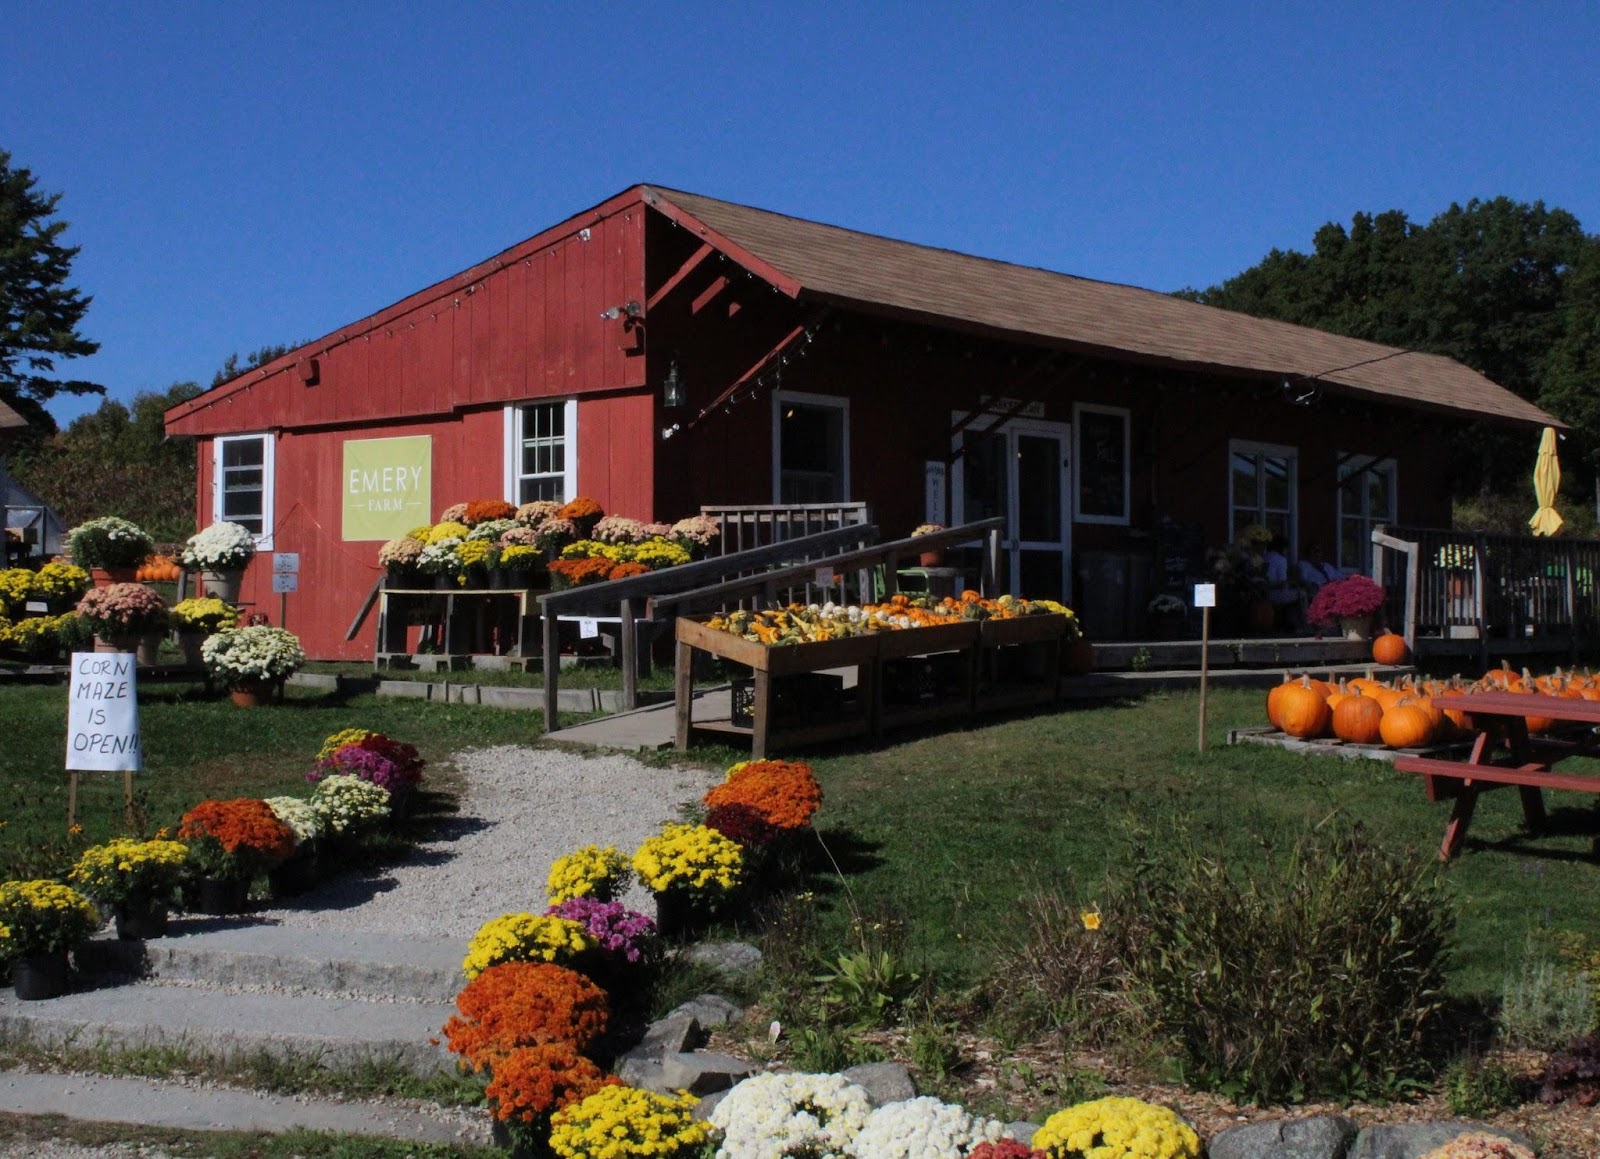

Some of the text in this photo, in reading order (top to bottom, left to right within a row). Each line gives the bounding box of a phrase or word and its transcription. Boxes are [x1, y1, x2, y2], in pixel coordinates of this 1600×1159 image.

[349, 465, 422, 494] EMERY
[368, 498, 403, 512] FARM
[79, 659, 129, 676] CORN
[77, 681, 128, 700] MAZE
[88, 708, 106, 725] IS
[73, 733, 138, 754] OPEN!!
